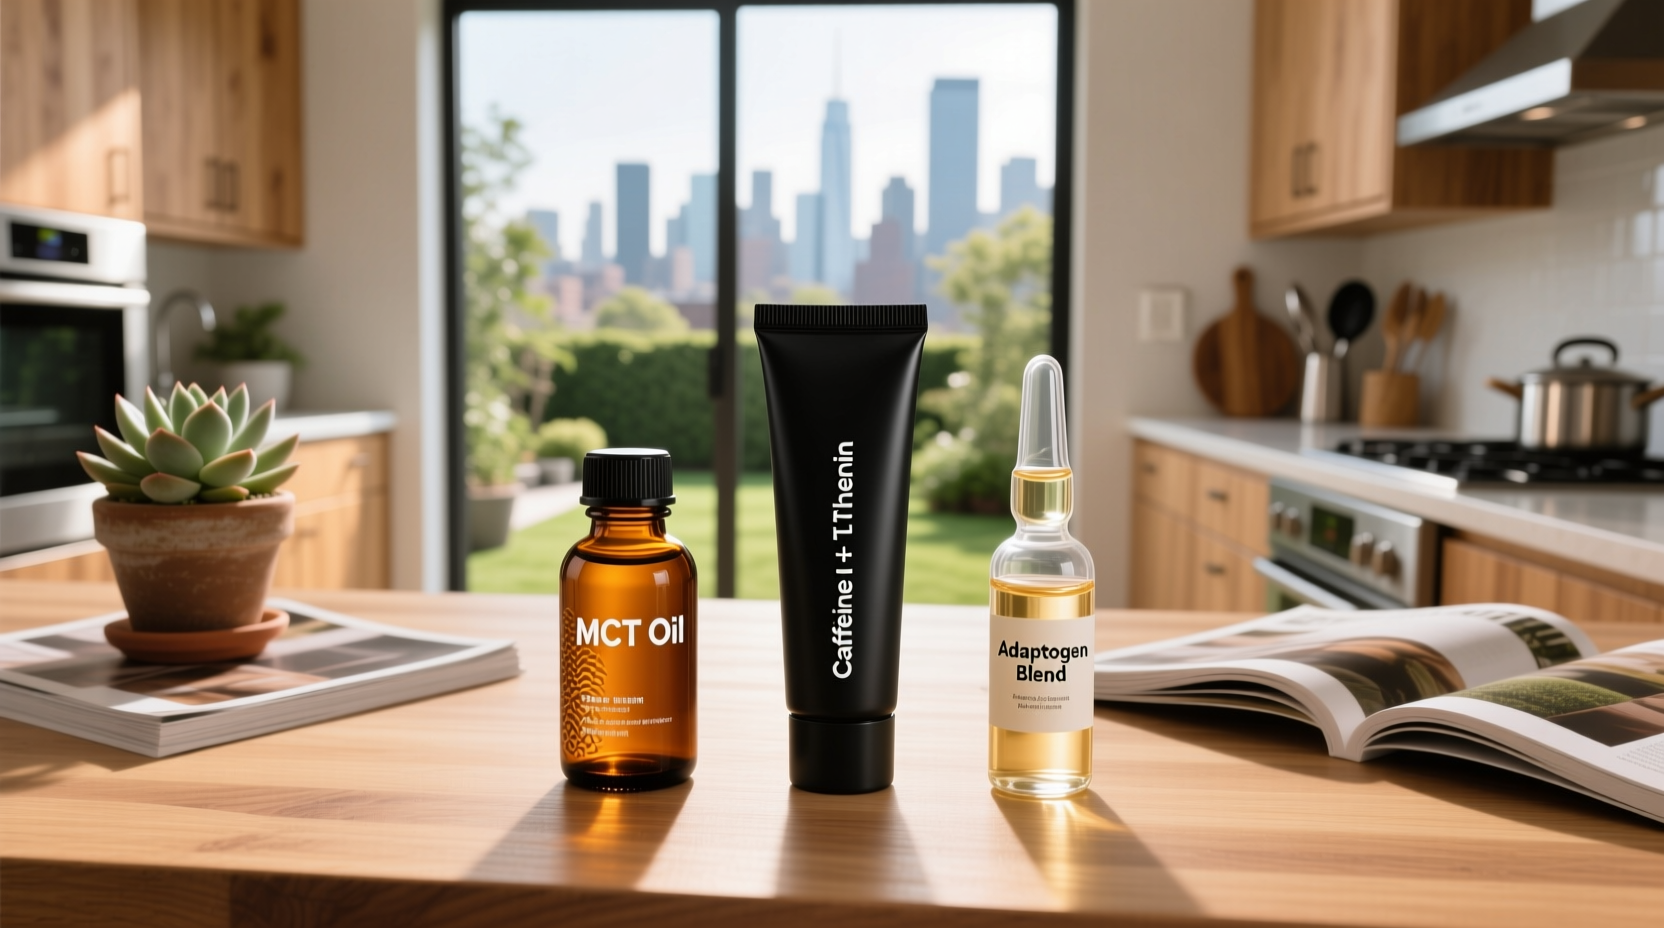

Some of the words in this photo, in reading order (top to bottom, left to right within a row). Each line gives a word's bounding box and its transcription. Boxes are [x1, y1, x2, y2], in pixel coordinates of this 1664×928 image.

[576, 616, 642, 648] MCT
[648, 614, 684, 646] Oil
[832, 579, 853, 679] Caffeine
[998, 639, 1088, 664] Adaptogen
[1016, 664, 1067, 683] Blend
